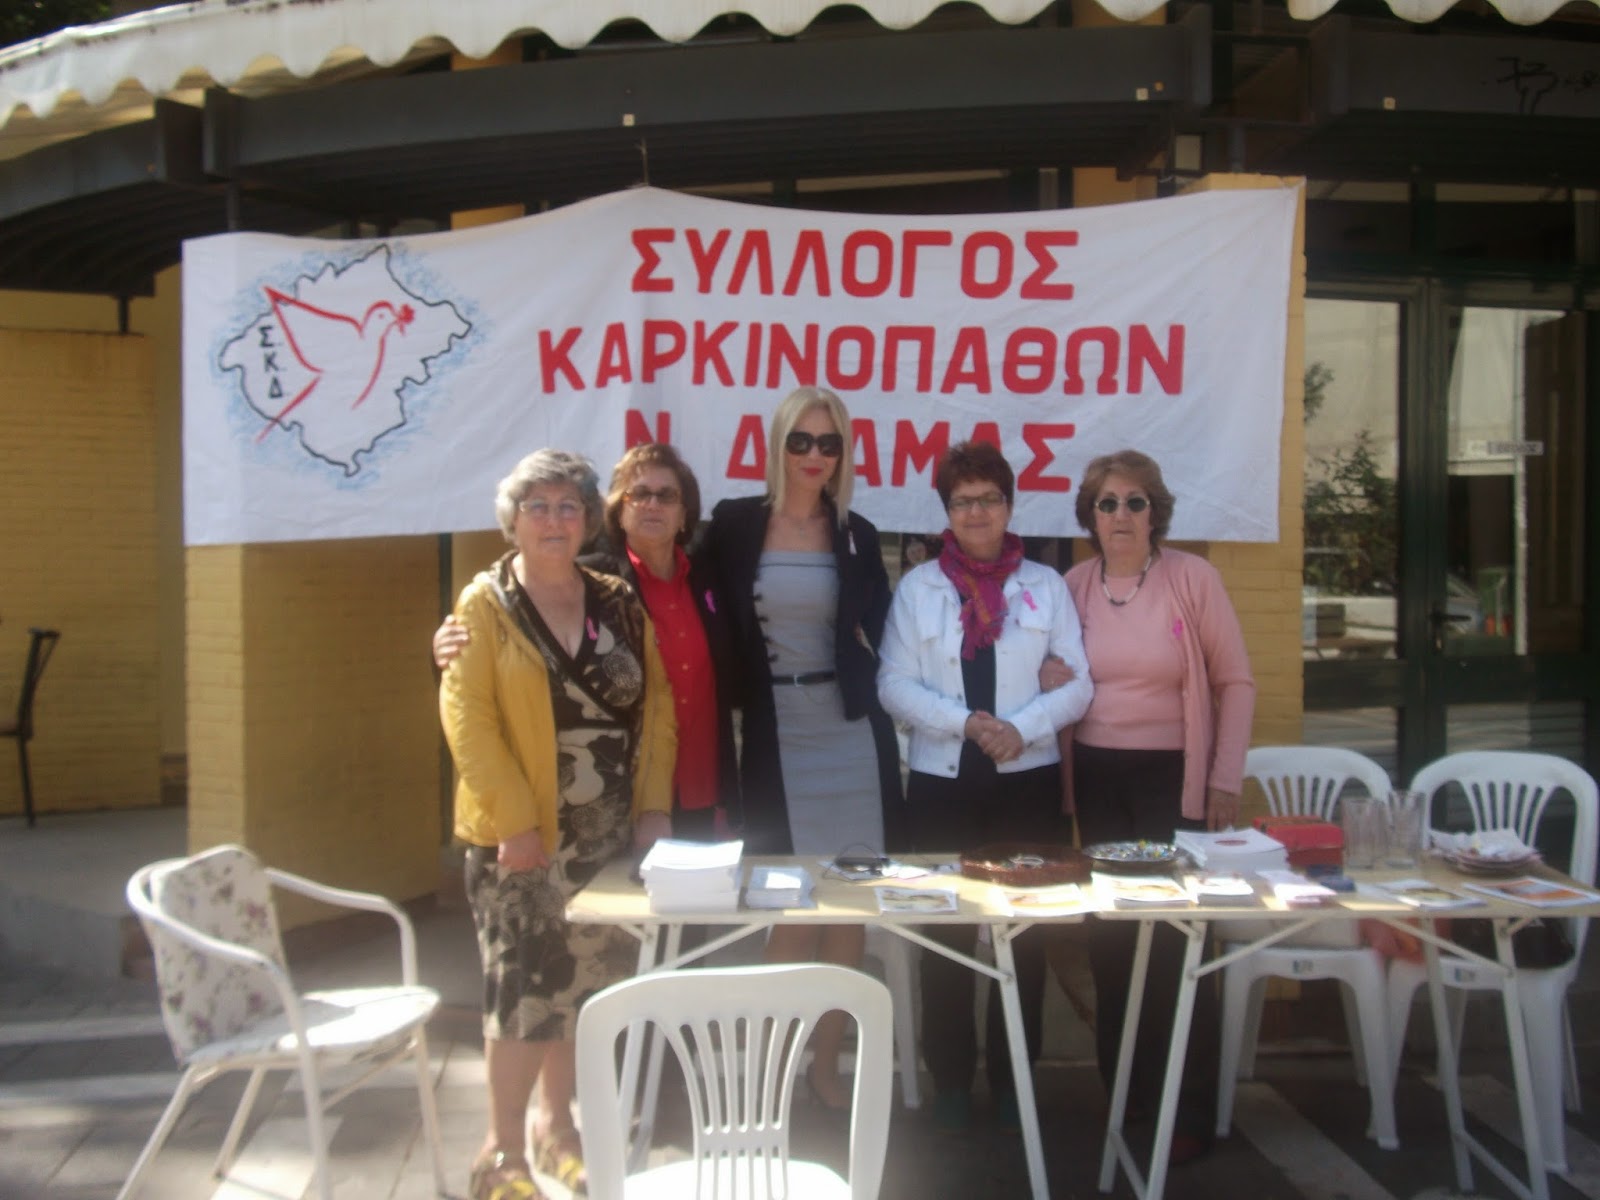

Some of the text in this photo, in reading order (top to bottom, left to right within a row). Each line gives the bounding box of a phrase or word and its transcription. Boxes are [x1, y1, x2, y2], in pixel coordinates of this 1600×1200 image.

[630, 227, 1080, 301] ΣΥΛΛΟΓΟΣ
[537, 318, 1186, 396] ΚΑΡΚΙΝΟΠΑΘΩΝ
[725, 413, 1076, 493] ΔΑΜΣ
